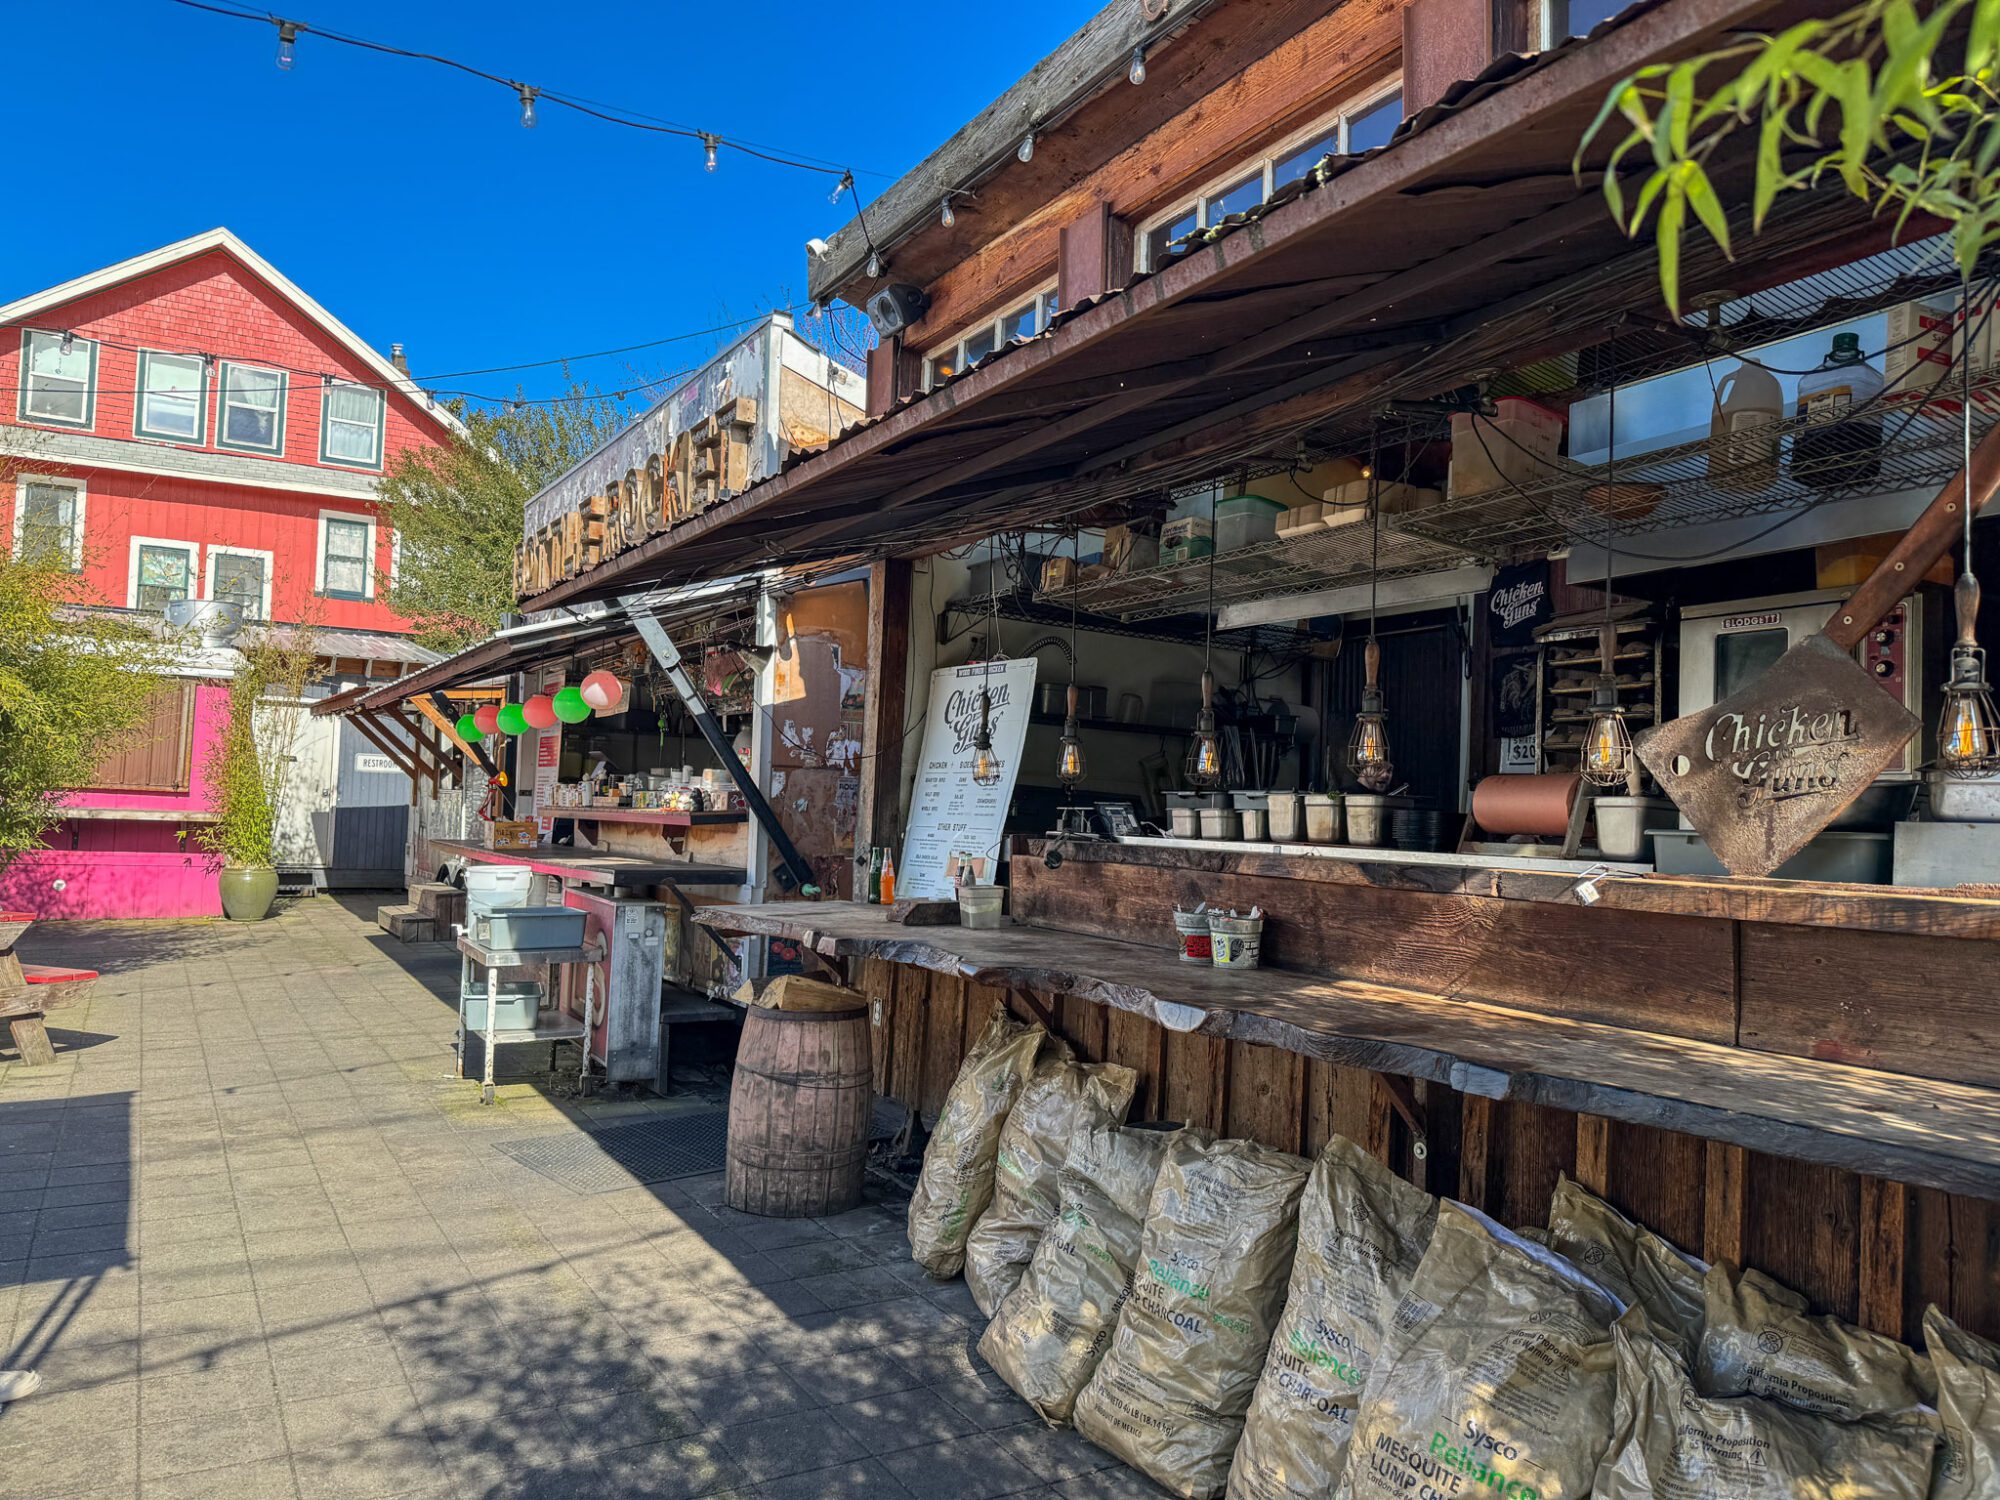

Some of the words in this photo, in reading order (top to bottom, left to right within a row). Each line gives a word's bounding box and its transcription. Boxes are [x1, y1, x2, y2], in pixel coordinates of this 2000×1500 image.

[1490, 577, 1545, 615] Chicken
[1502, 596, 1541, 629] Guns
[1724, 613, 1779, 629] BLODGETT
[1705, 705, 1861, 763] Chicken
[1513, 744, 1536, 760] $20
[1733, 752, 1849, 809] Guns
[1170, 1250, 1199, 1271] Sysco
[1149, 1258, 1211, 1301] Reliance
[1141, 1295, 1202, 1333] CHARCOAL
[1086, 1329, 1107, 1358] Sysco
[1314, 1319, 1351, 1349] Sysco
[1521, 1339, 1555, 1367] Warning
[1537, 1333, 1581, 1368] Proposition
[1790, 1379, 1851, 1409] Proposition
[1113, 1416, 1121, 1427] OF
[1121, 1422, 1143, 1440] MEXICO
[1131, 1407, 1140, 1419] LB
[1463, 1420, 1518, 1461] Sysco
[1701, 1440, 1743, 1462] Warning
[1715, 1433, 1771, 1450] Proposition
[1370, 1452, 1418, 1490] LUMP
[1375, 1431, 1463, 1495] MESQUITE
[1428, 1431, 1538, 1500] Reliance
[1366, 1471, 1393, 1492] Carbon
